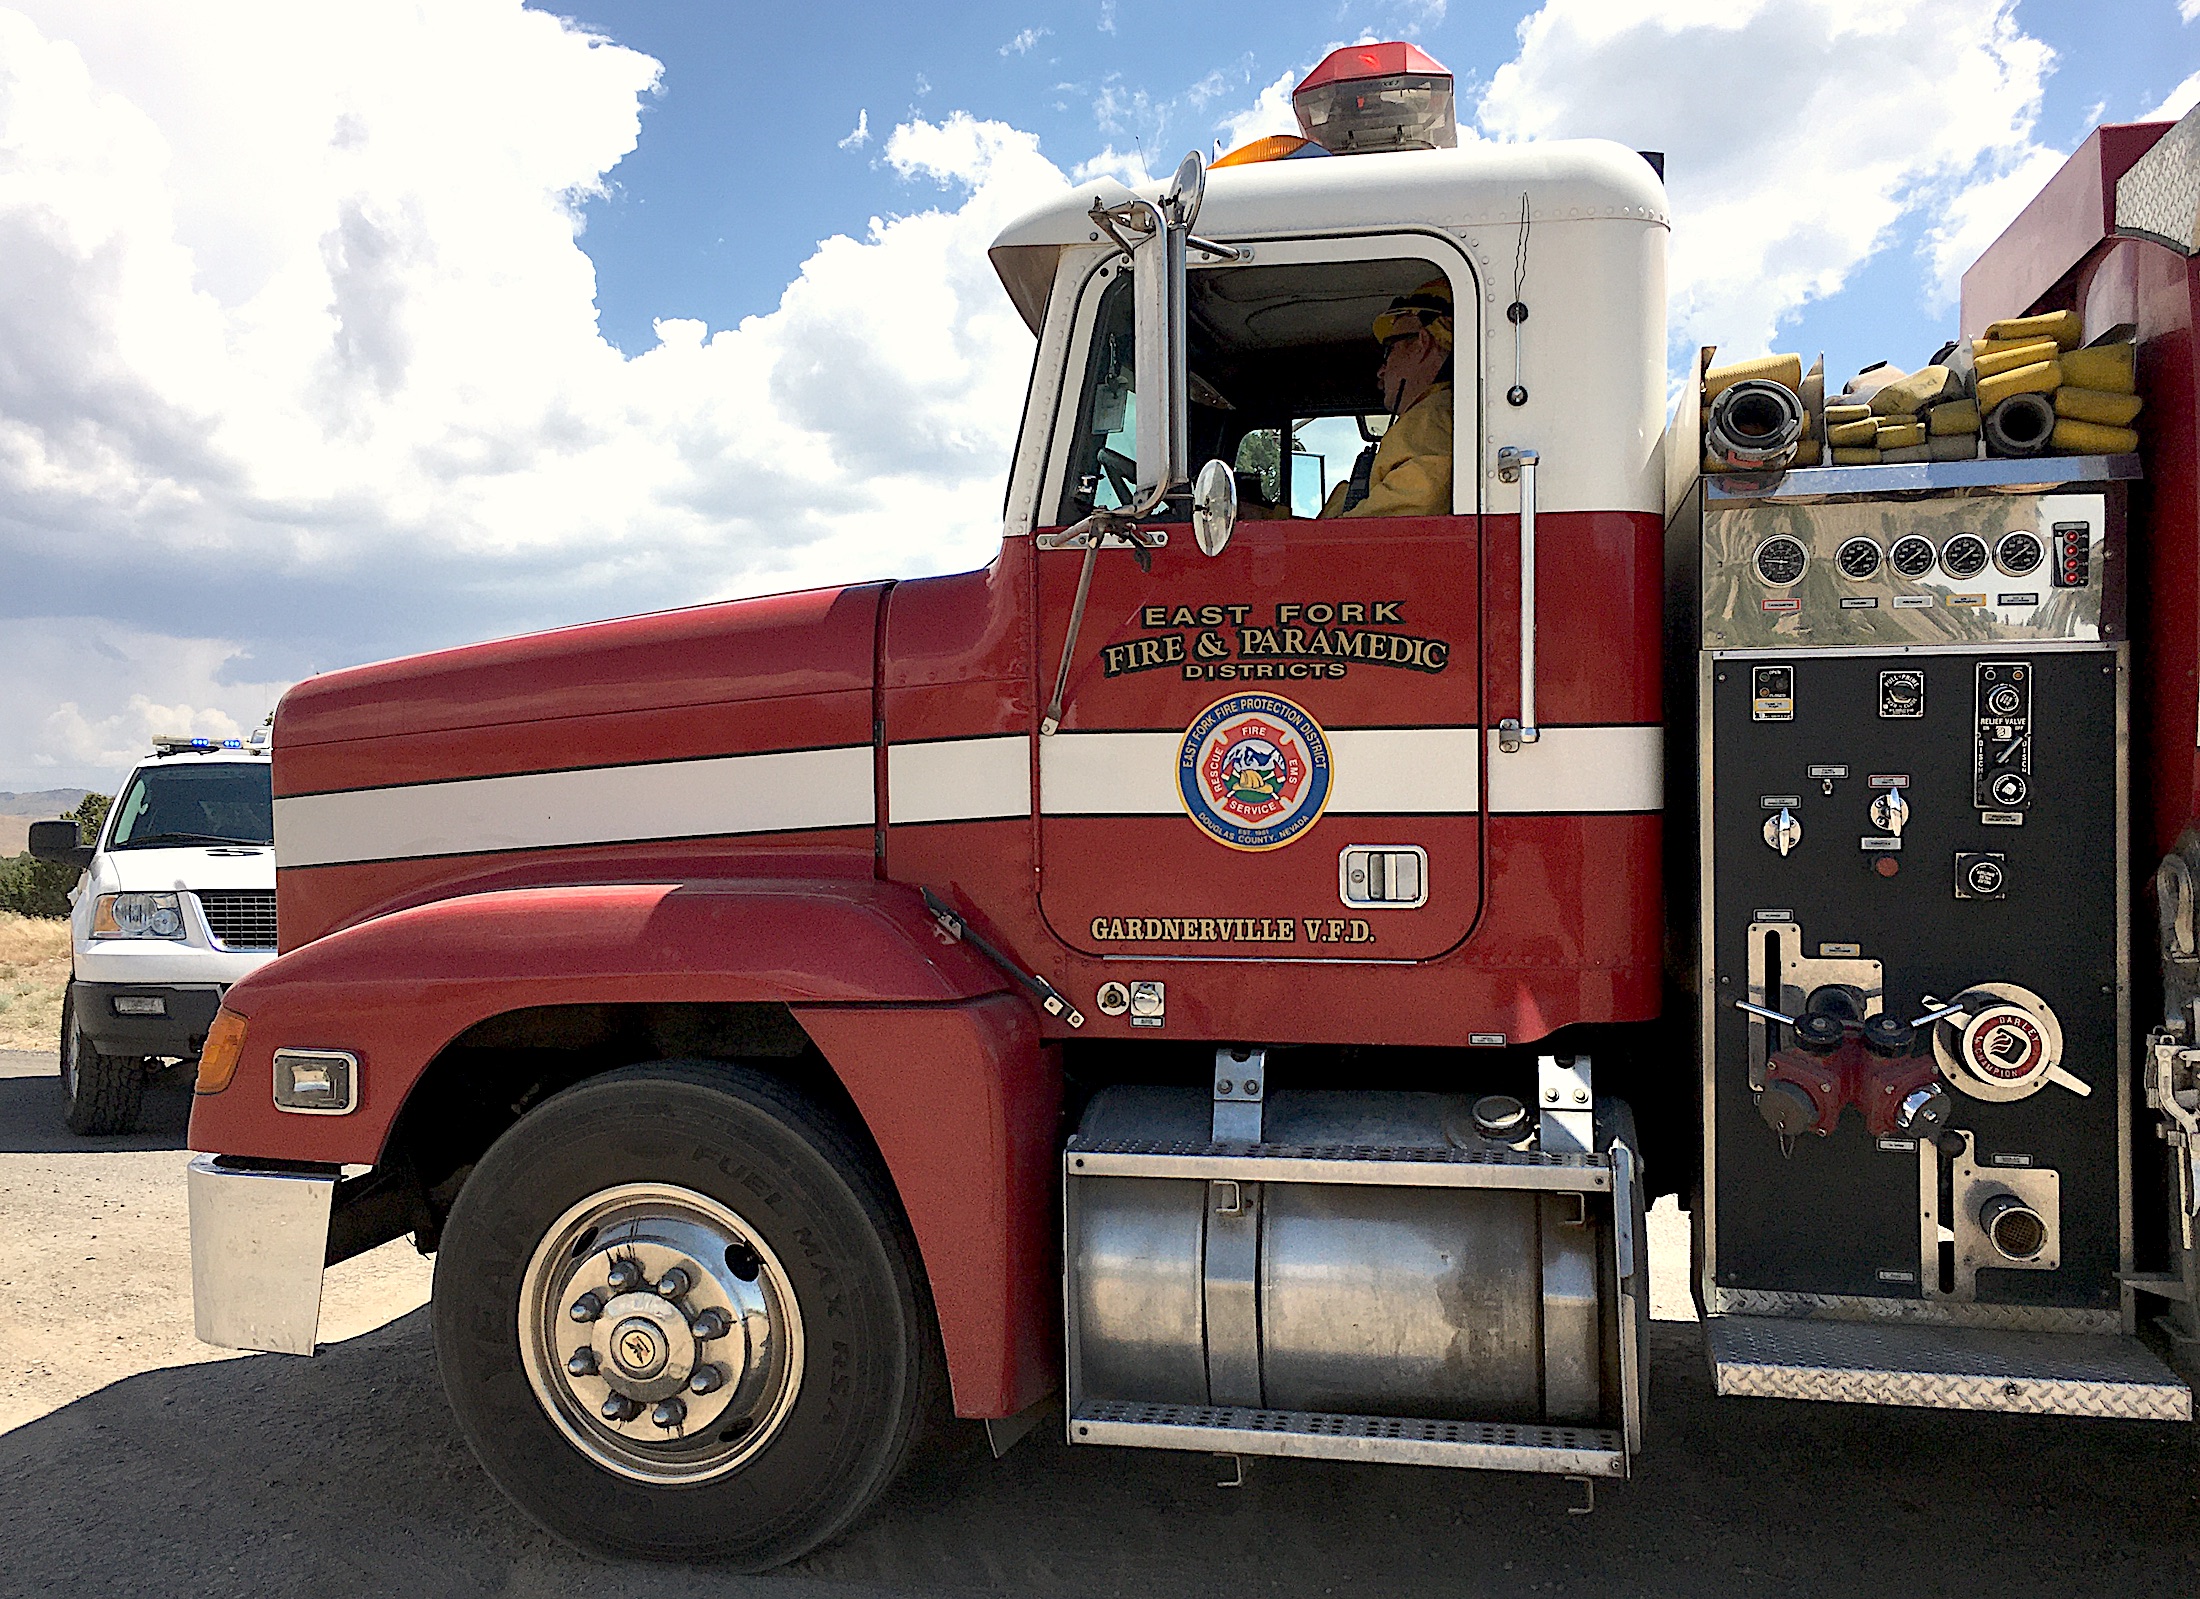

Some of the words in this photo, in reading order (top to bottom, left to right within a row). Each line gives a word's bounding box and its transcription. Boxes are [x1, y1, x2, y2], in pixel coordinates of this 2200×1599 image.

[1143, 604, 1252, 627] EAST
[1278, 601, 1402, 625] FORK
[1104, 633, 1186, 674] FIRE
[1197, 631, 1228, 658] &
[1239, 627, 1448, 670] PARAMEDIC
[1184, 662, 1347, 679] DISTRICTS
[1182, 740, 1197, 768] EAST
[1191, 715, 1217, 740] FORK
[1215, 702, 1239, 720] FIRE
[1240, 698, 1303, 726] PROTECTION
[1299, 722, 1327, 769] DISTRICT
[1241, 726, 1267, 737] FIRE
[2004, 717, 2026, 725] VALVE
[1209, 746, 1224, 793] RESCUE
[1288, 759, 1299, 785] EMS
[1229, 799, 1277, 815] SERVICE
[1198, 812, 1235, 840] DOUGLAS
[1279, 815, 1309, 839] NEVADA
[1091, 917, 1295, 942] GARDNERVILLE
[1303, 918, 1376, 943] V.F.D.
[1998, 1016, 2040, 1041] DARLEY
[1974, 1048, 2018, 1078] CHAMPION
[690, 1145, 784, 1217] FUEL
[792, 1226, 846, 1318] MAX
